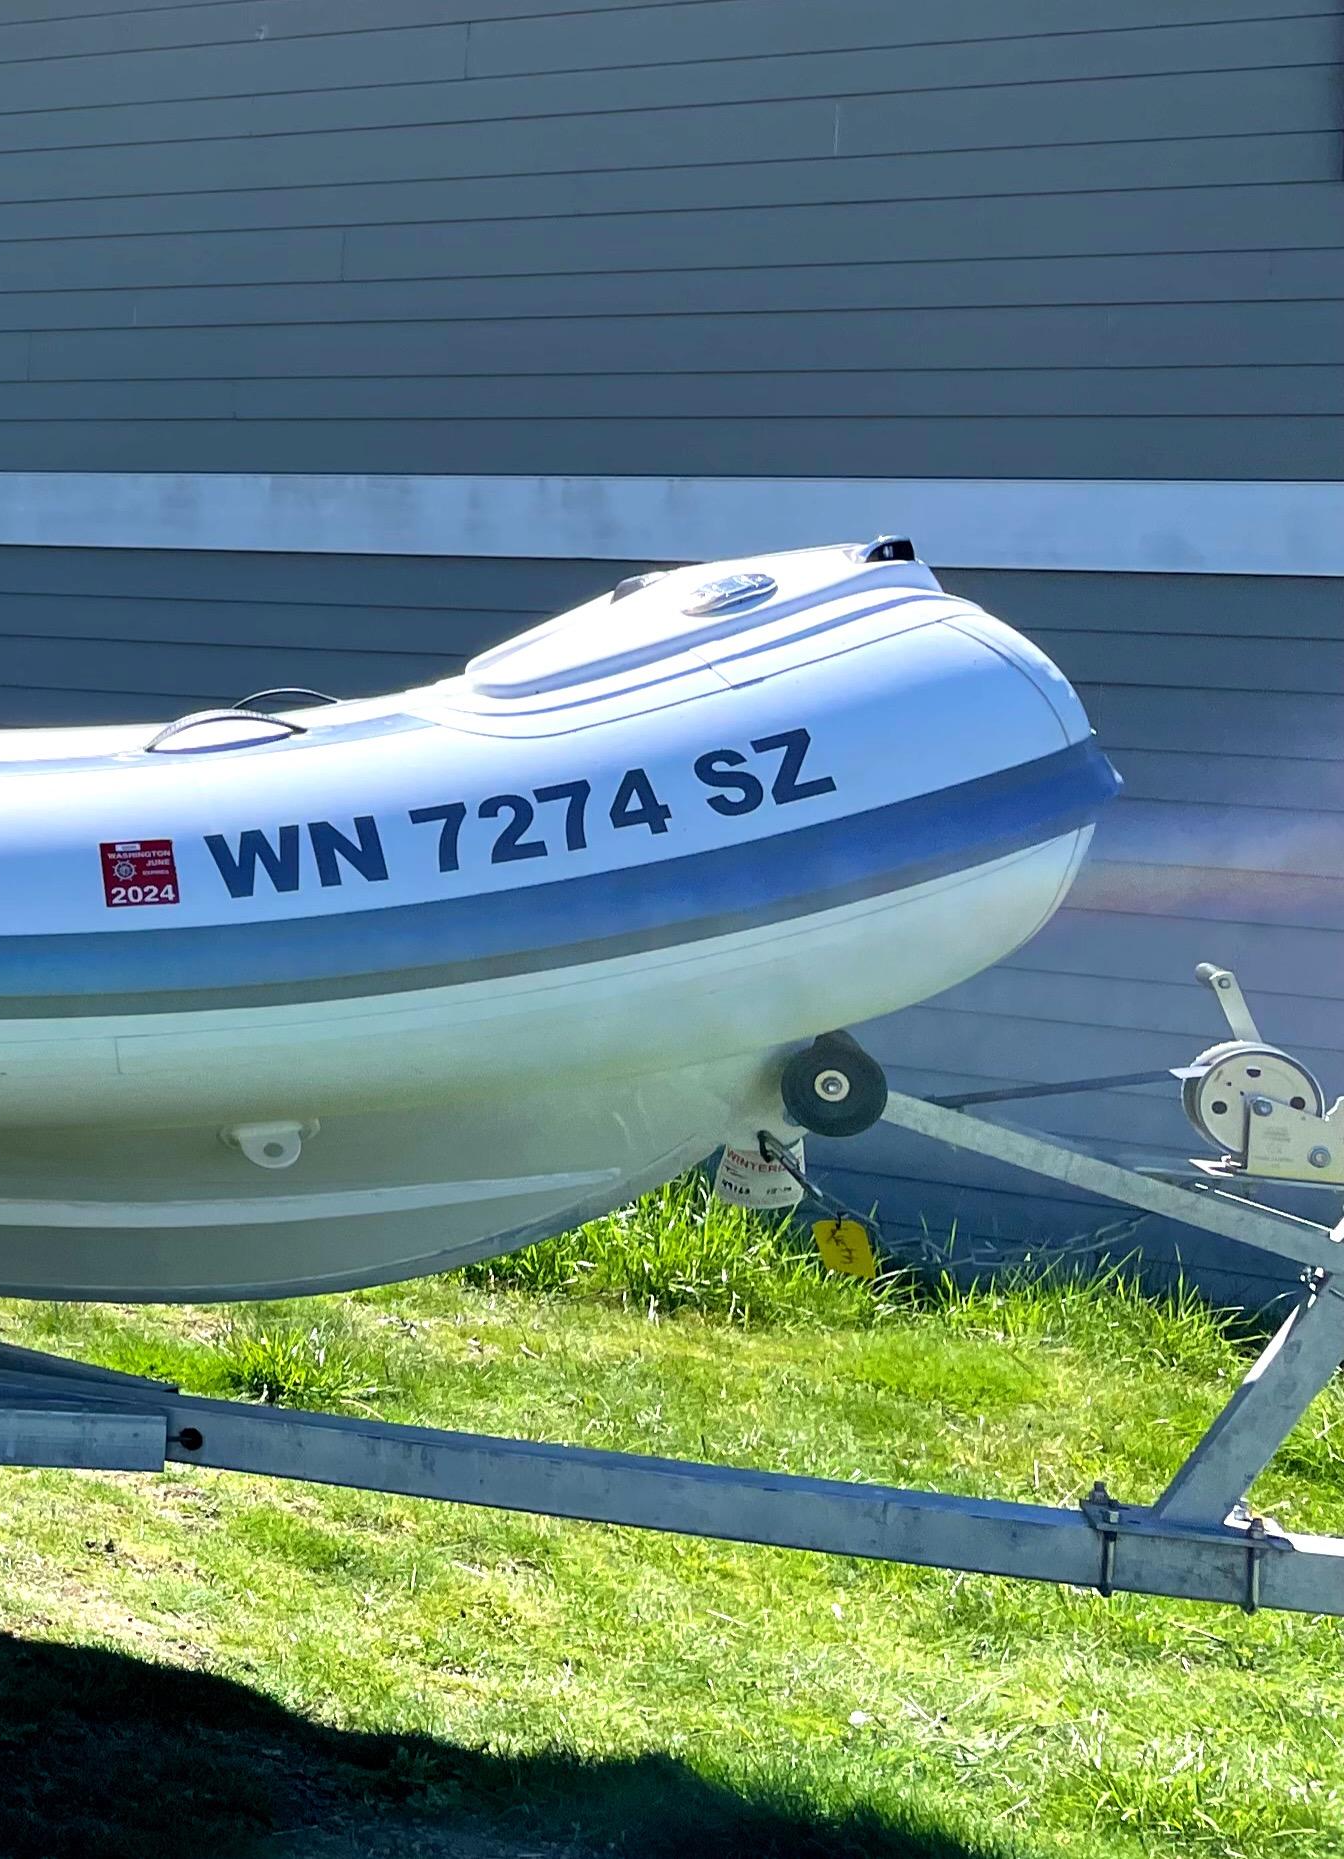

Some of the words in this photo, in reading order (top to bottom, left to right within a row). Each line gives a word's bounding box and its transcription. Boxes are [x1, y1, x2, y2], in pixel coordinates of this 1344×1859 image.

[204, 815, 390, 899] WN
[408, 767, 673, 873] 7274
[693, 726, 837, 818] SZ
[107, 850, 171, 860] WASHINGTON
[146, 859, 170, 867] JUNE
[111, 884, 176, 905] 2024
